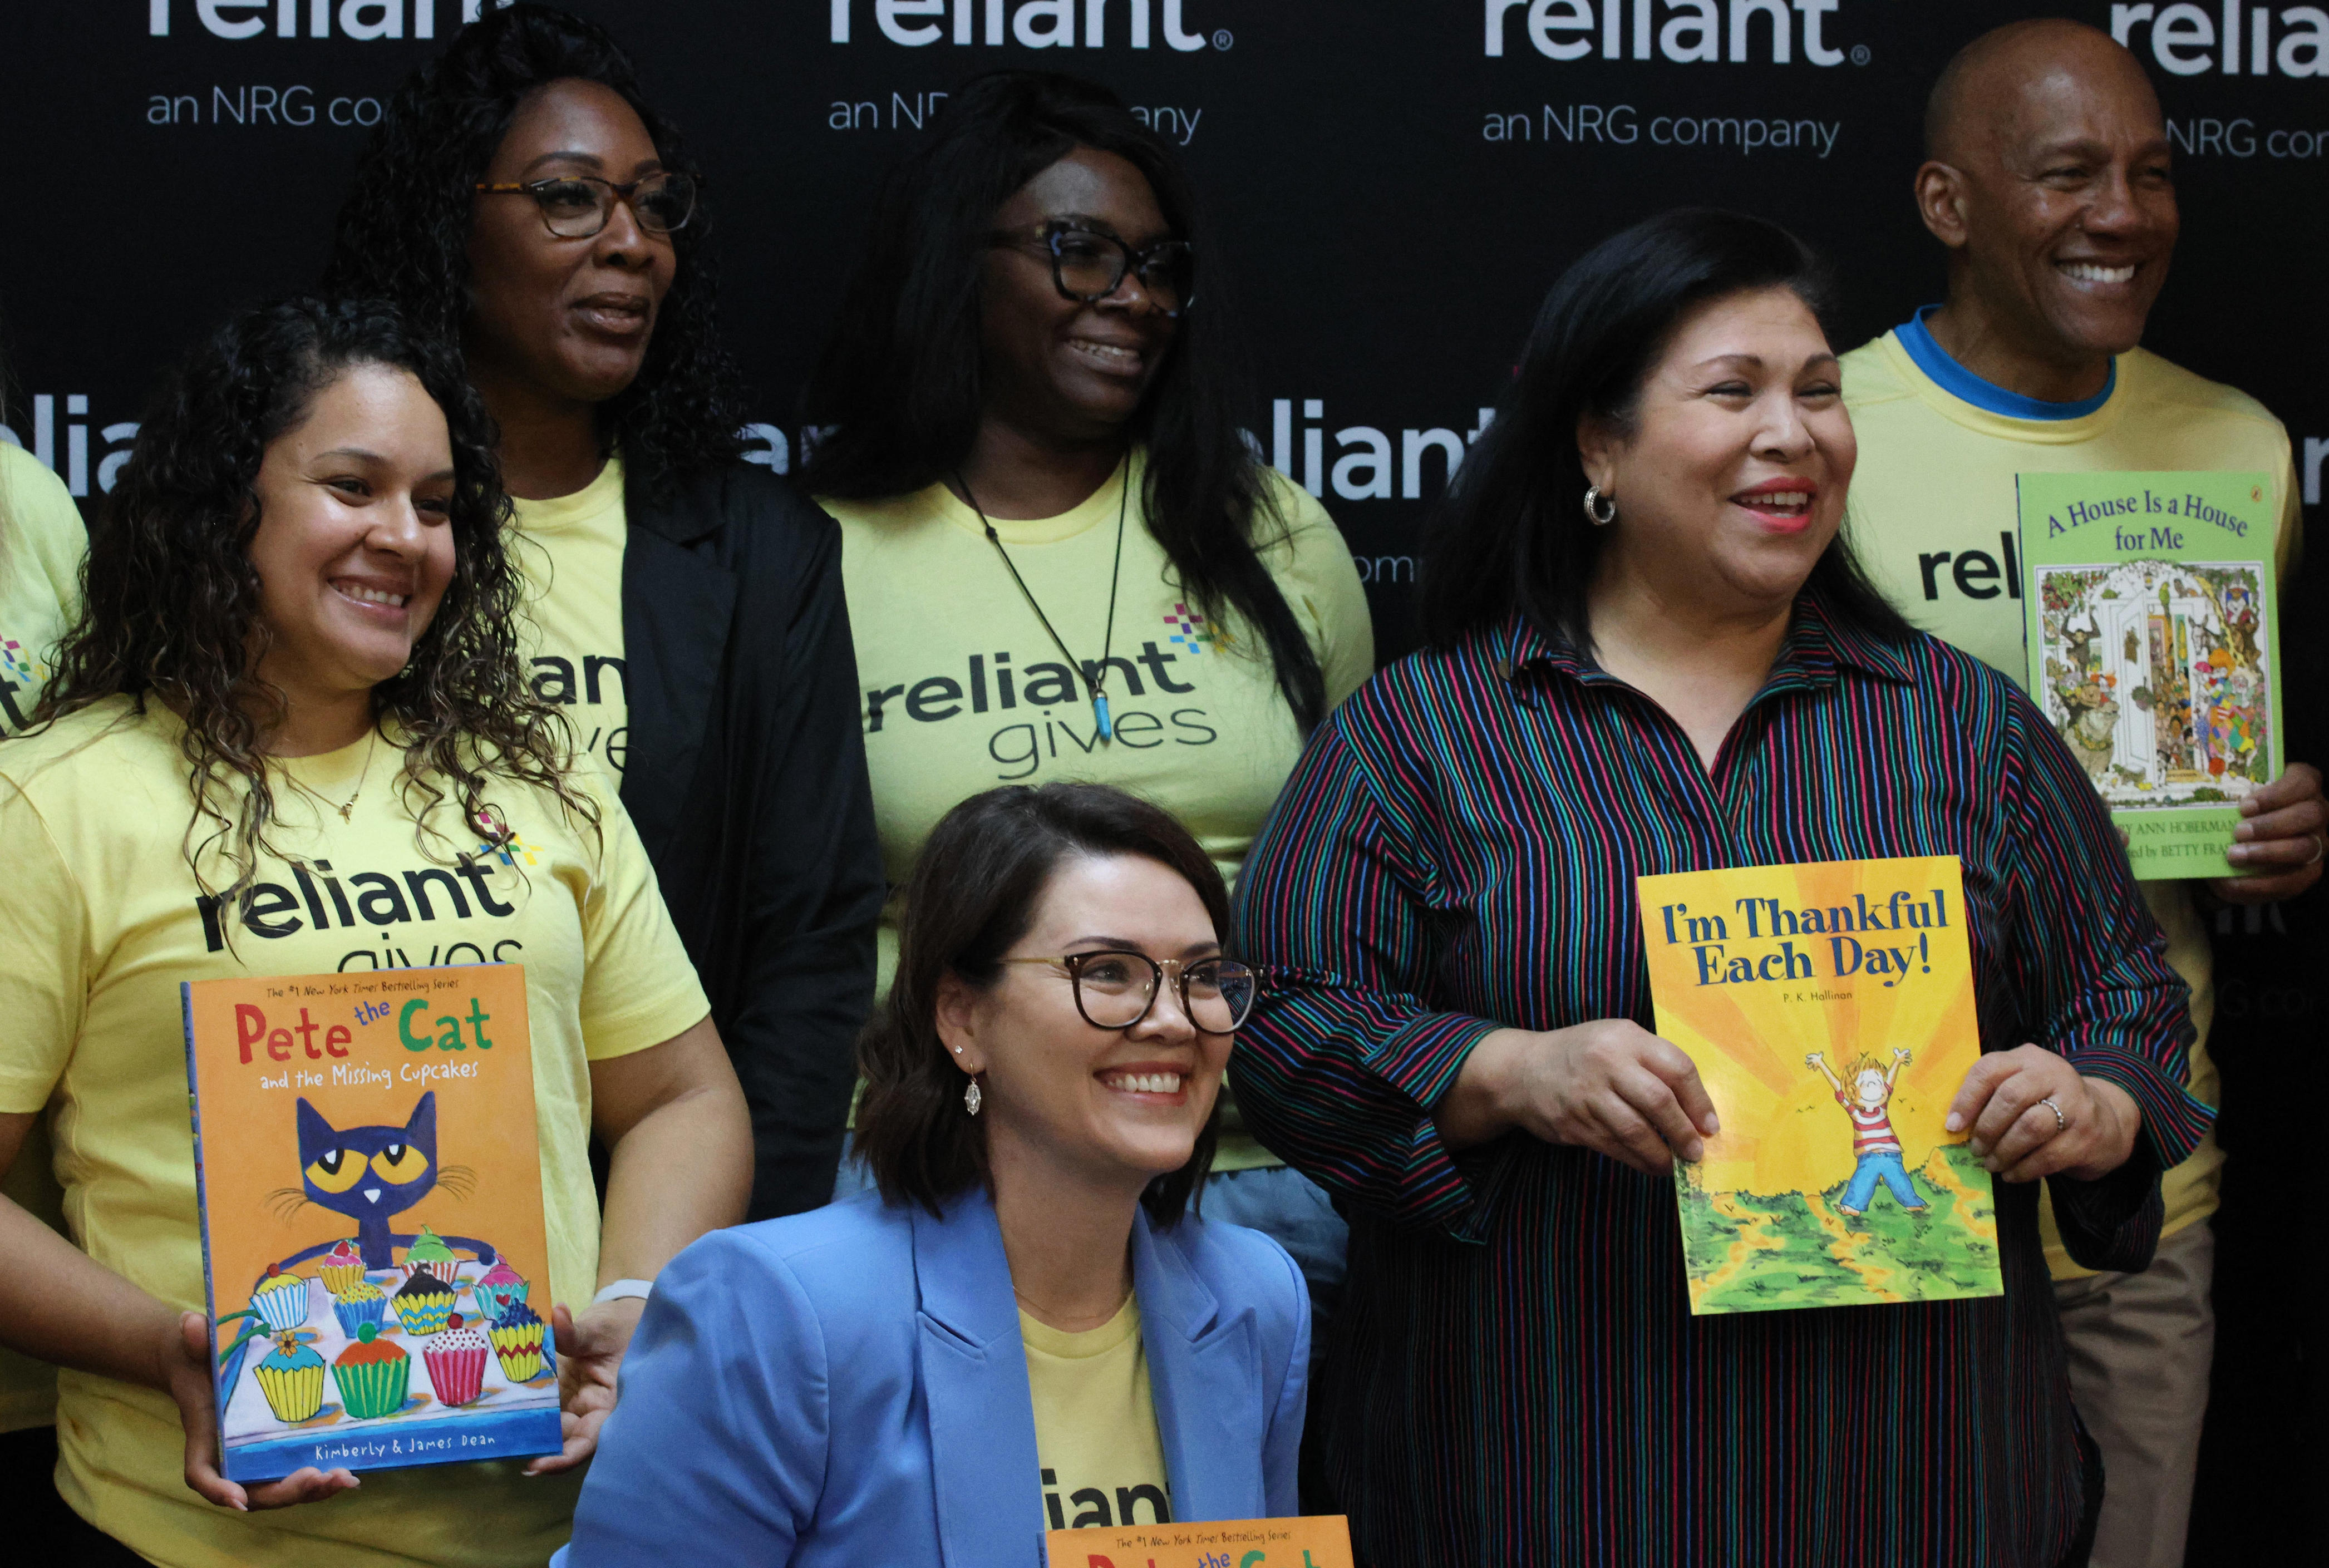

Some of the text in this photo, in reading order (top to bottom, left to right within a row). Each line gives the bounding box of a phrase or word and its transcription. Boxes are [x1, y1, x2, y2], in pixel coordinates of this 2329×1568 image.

[147, 85, 388, 126] an NRG co
[829, 100, 878, 130] an
[1483, 104, 1841, 158] an NRG company
[2166, 119, 2257, 157] NRG
[2049, 489, 2248, 539] A House Is a House
[2115, 525, 2184, 550] for Me
[867, 641, 1196, 733] reliant
[989, 709, 1217, 780] gives
[195, 852, 515, 952] reliant
[1659, 889, 1951, 945] I'm Thankful
[1692, 931, 1931, 987] Each Day!
[267, 976, 459, 998] The #1 New York Times Bestselling Series
[1783, 993, 1793, 1003] P.
[1810, 989, 1852, 1001] Hallinan
[234, 1003, 352, 1064] Pete
[354, 1000, 391, 1026] the
[398, 998, 493, 1052] Cat
[260, 1059, 479, 1089] and the Missing Cupcakes
[316, 1434, 495, 1461] Kimberly & James Dean
[1116, 1529, 1291, 1549] The #1 New York Times Bestselling Series
